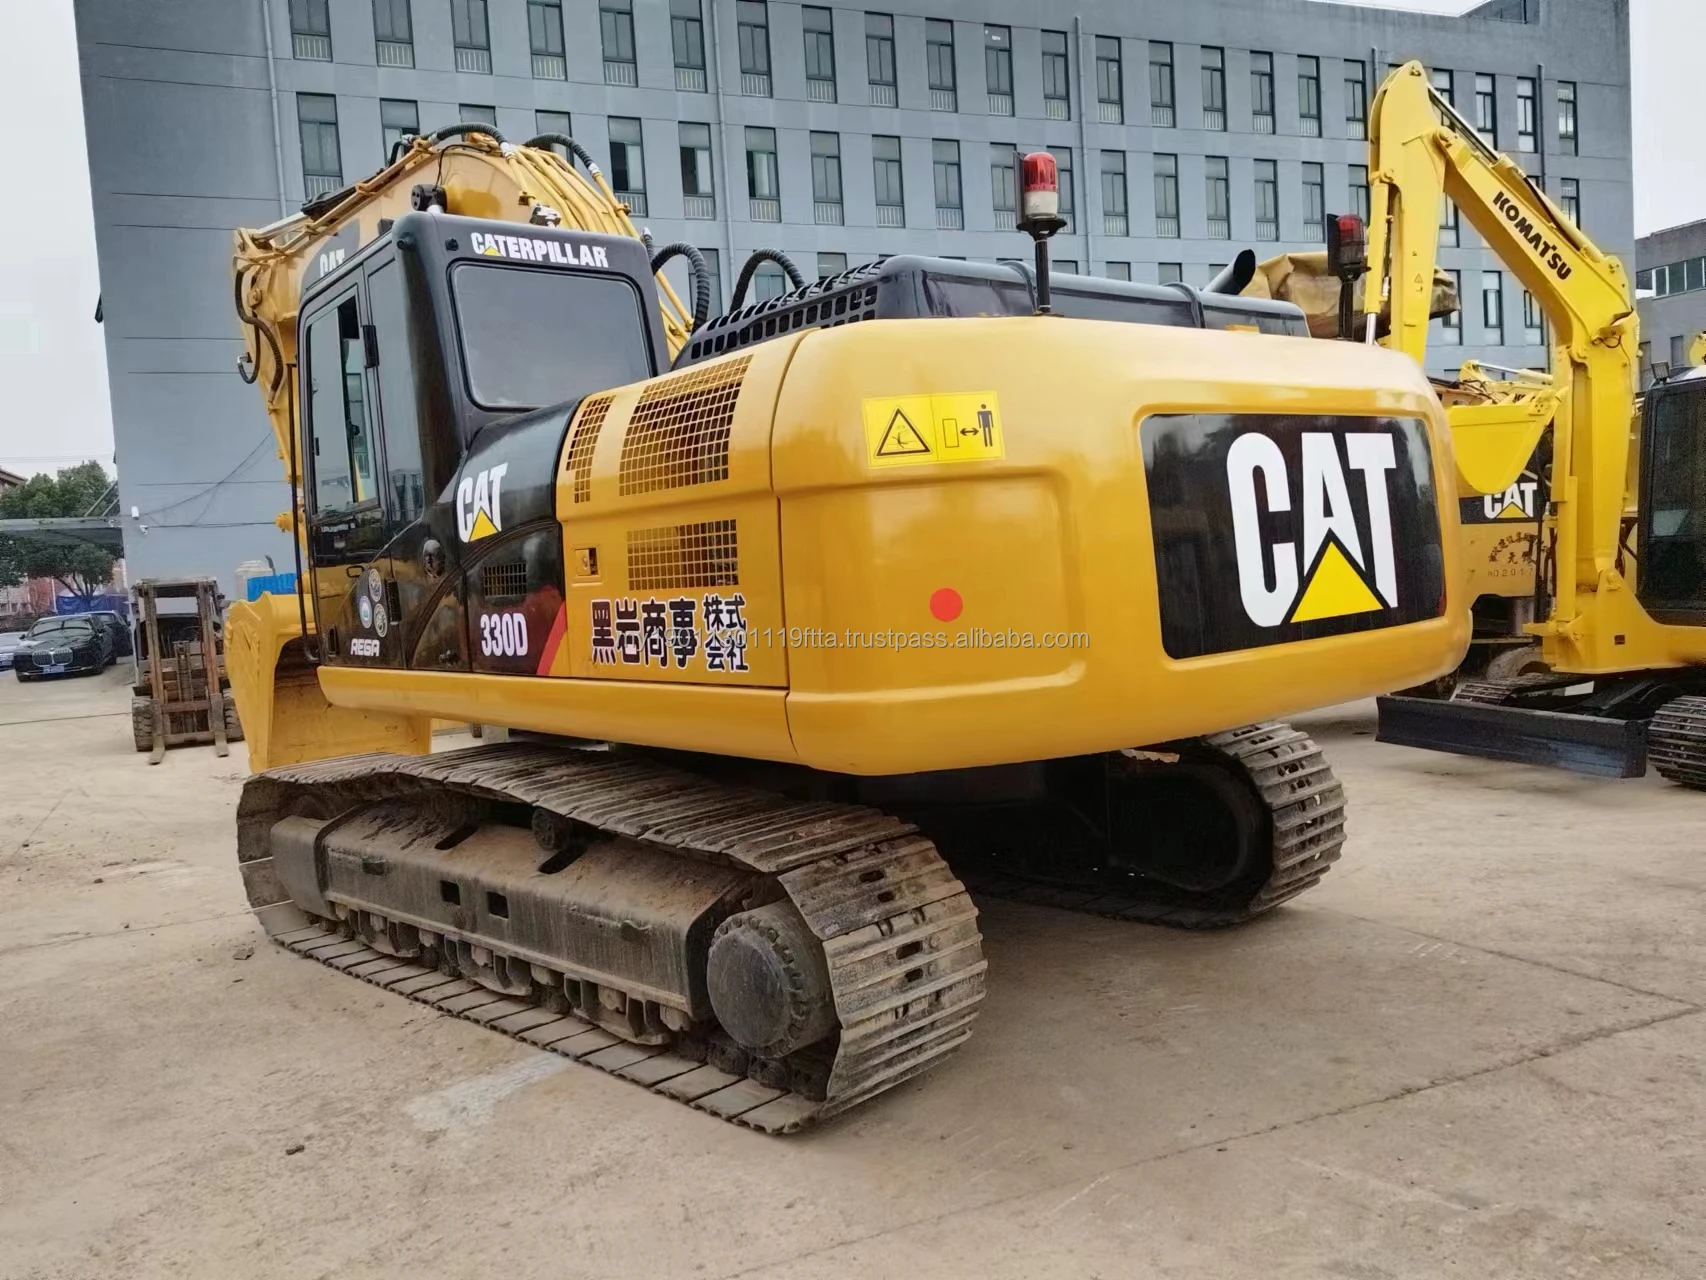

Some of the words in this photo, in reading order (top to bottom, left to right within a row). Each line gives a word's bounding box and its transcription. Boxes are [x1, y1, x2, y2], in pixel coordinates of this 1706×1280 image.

[470, 232, 609, 268] CATERPILLAR
[1492, 191, 1572, 280] KOMATSU
[456, 462, 508, 543] CAT
[1483, 482, 1537, 519] CAT
[1226, 432, 1399, 628] CAT
[480, 612, 529, 657] 330D
[591, 596, 698, 668] 黒岩商事
[702, 592, 748, 631] 株式
